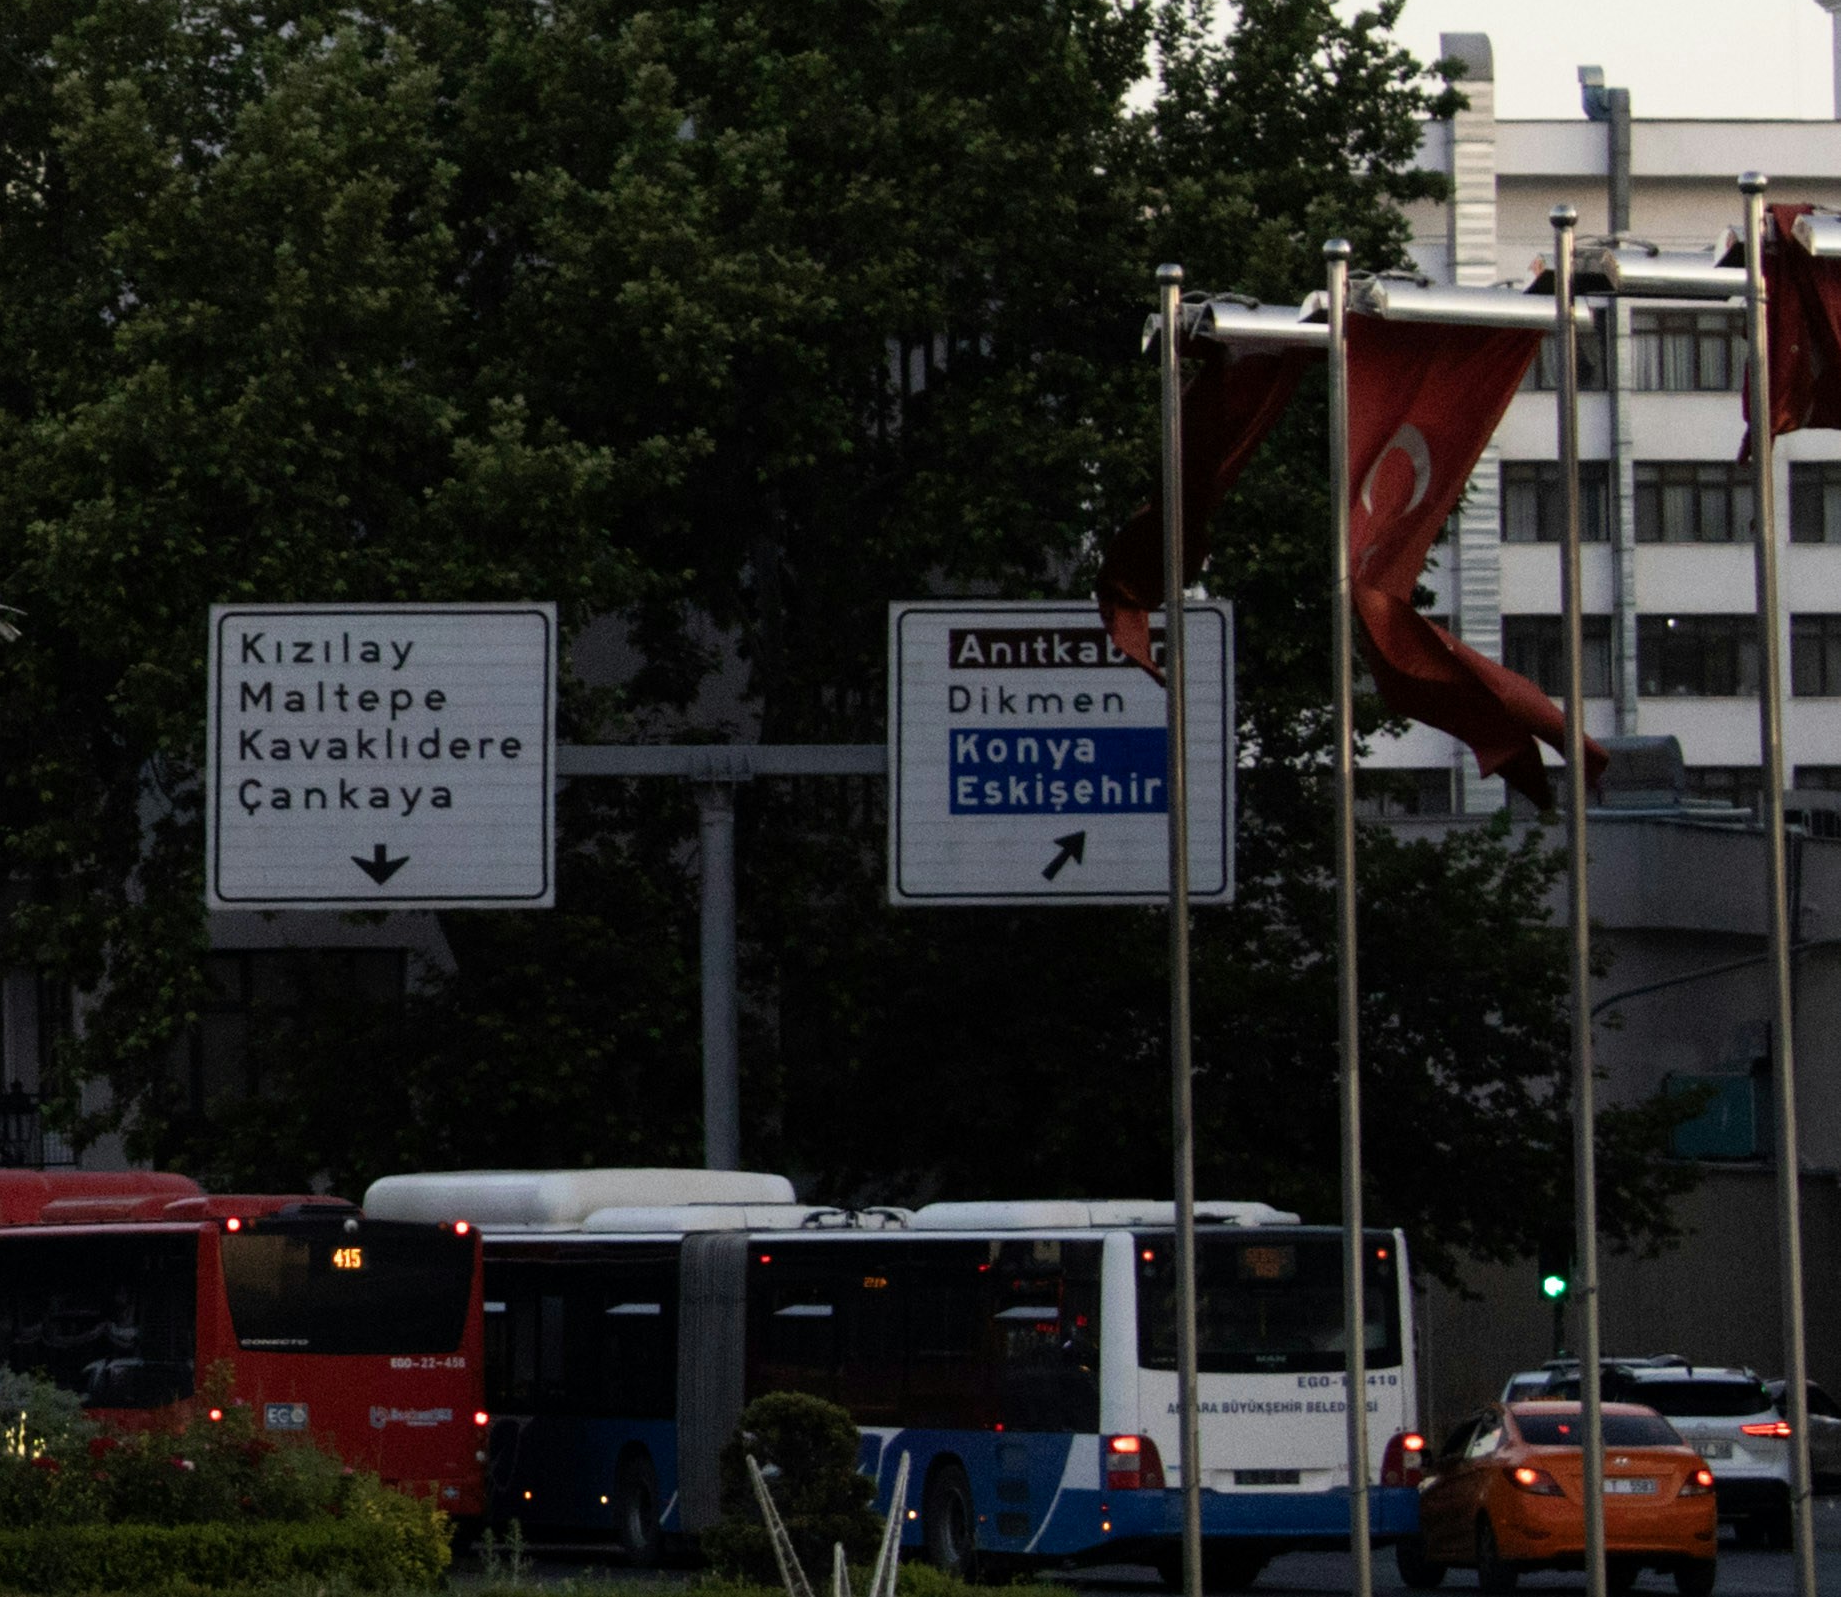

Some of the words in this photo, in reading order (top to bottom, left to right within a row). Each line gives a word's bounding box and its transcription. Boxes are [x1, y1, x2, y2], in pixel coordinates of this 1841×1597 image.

[240, 632, 415, 671] Kızılay
[239, 681, 448, 721] Maltepe
[948, 685, 1125, 715] Dikmen
[238, 727, 523, 761] Kavaklıdere
[955, 733, 1097, 772] Konya
[238, 778, 453, 817] Çankaya
[955, 771, 1164, 812] Eskişehir
[332, 1247, 363, 1269] 415
[1222, 1399, 1302, 1416] BÜYÜKŞEHİR
